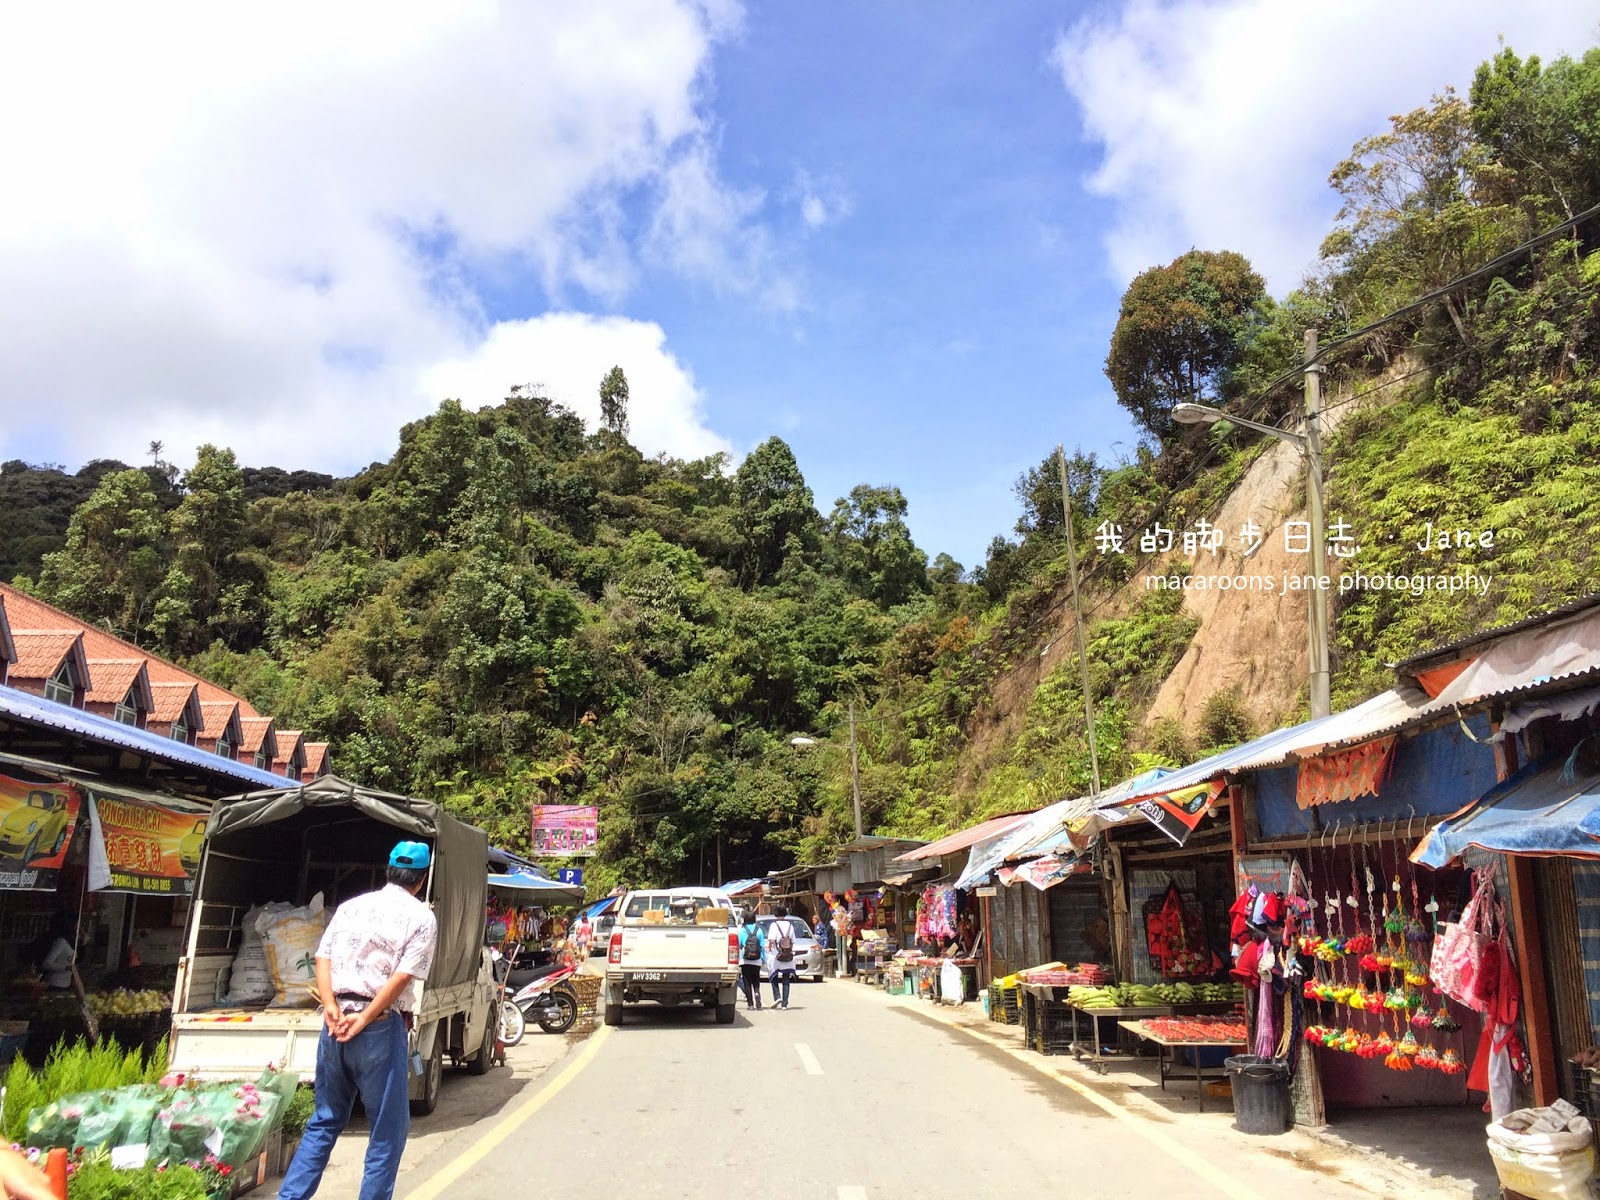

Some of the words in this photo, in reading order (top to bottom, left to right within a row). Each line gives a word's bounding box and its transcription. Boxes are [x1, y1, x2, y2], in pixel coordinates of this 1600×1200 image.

[147, 809, 161, 834] CAI
[566, 871, 574, 881] P
[632, 973, 645, 981] AHV
[645, 973, 661, 981] 3362
